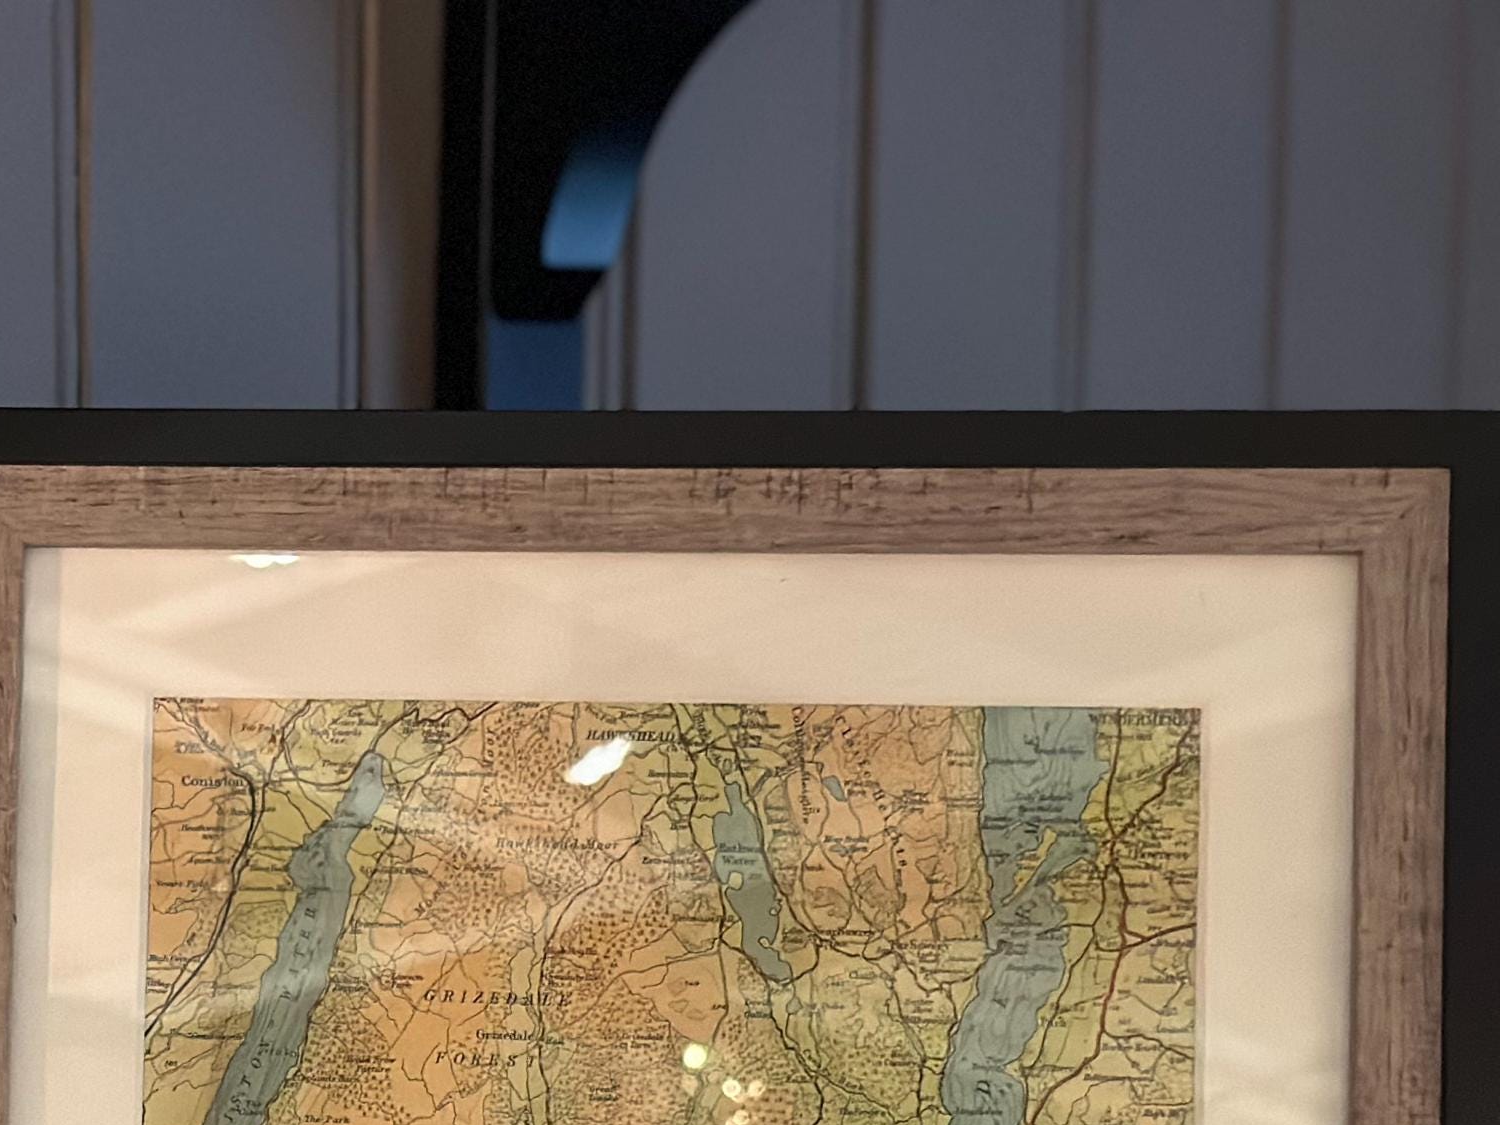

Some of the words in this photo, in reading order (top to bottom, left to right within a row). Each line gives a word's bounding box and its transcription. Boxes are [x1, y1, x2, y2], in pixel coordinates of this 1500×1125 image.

[181, 775, 245, 787] Coniston
[423, 989, 571, 1007] GRIZEDALE
[435, 1053, 537, 1068] FOREST
[326, 1115, 350, 1124] Park
